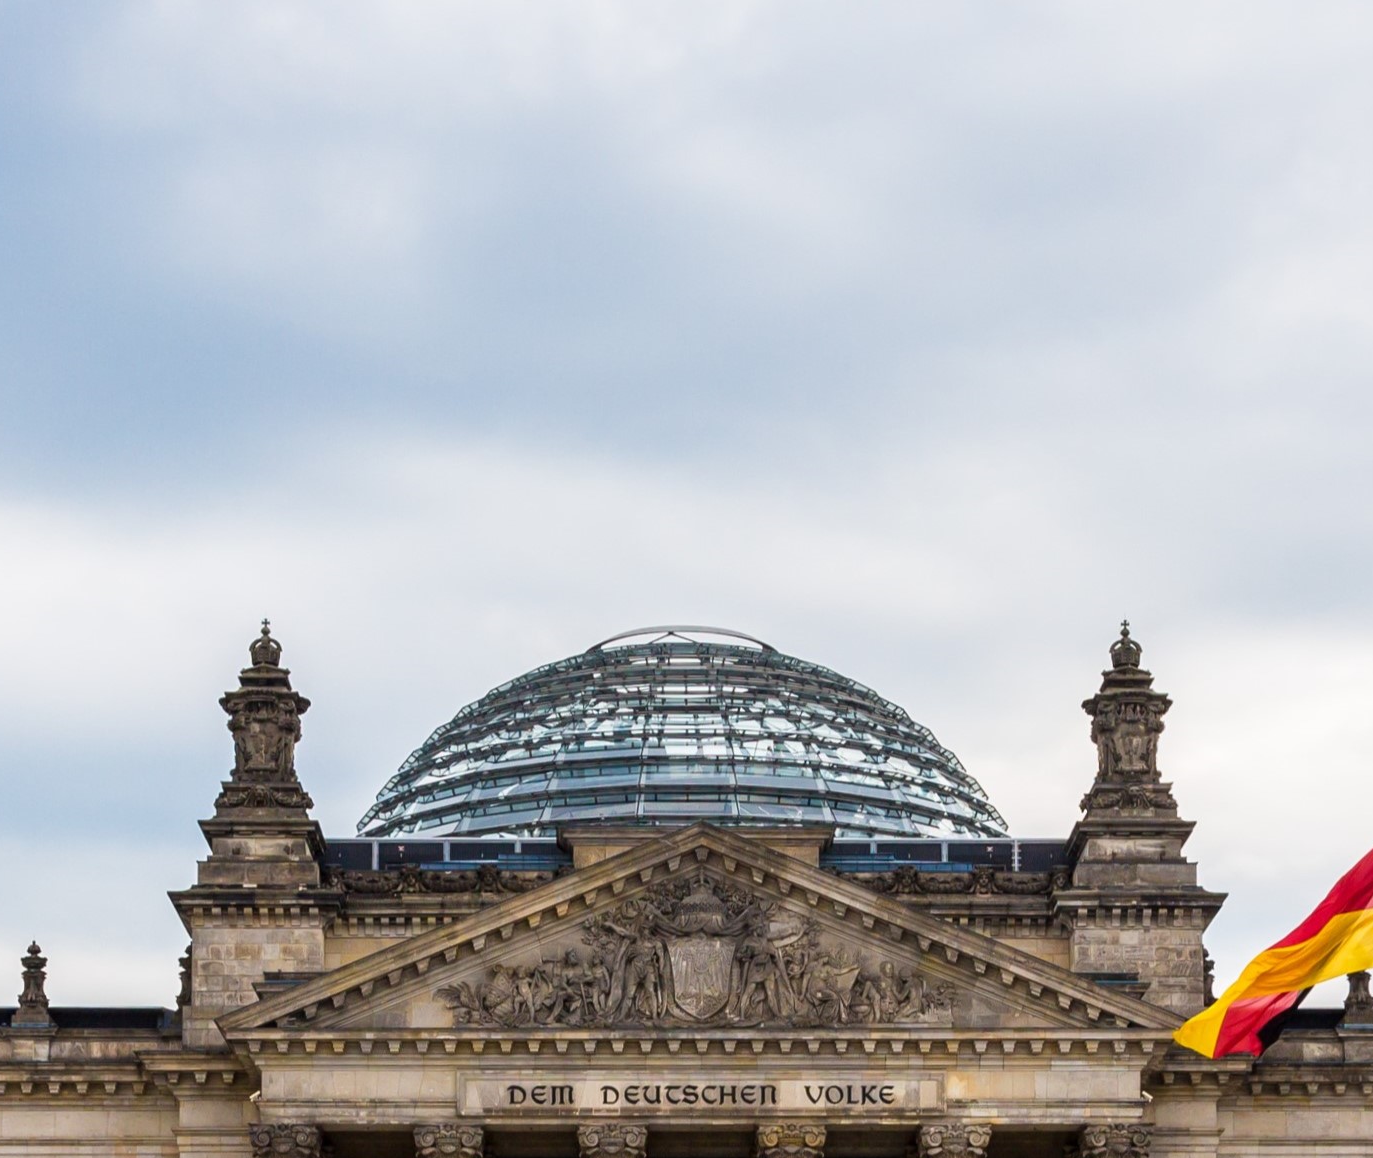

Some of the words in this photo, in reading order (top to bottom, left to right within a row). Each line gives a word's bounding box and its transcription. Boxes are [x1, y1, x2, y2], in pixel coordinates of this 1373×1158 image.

[507, 1085, 574, 1105] DEM
[600, 1085, 777, 1105] DEUTSCHEN
[804, 1085, 895, 1105] VOLKE
